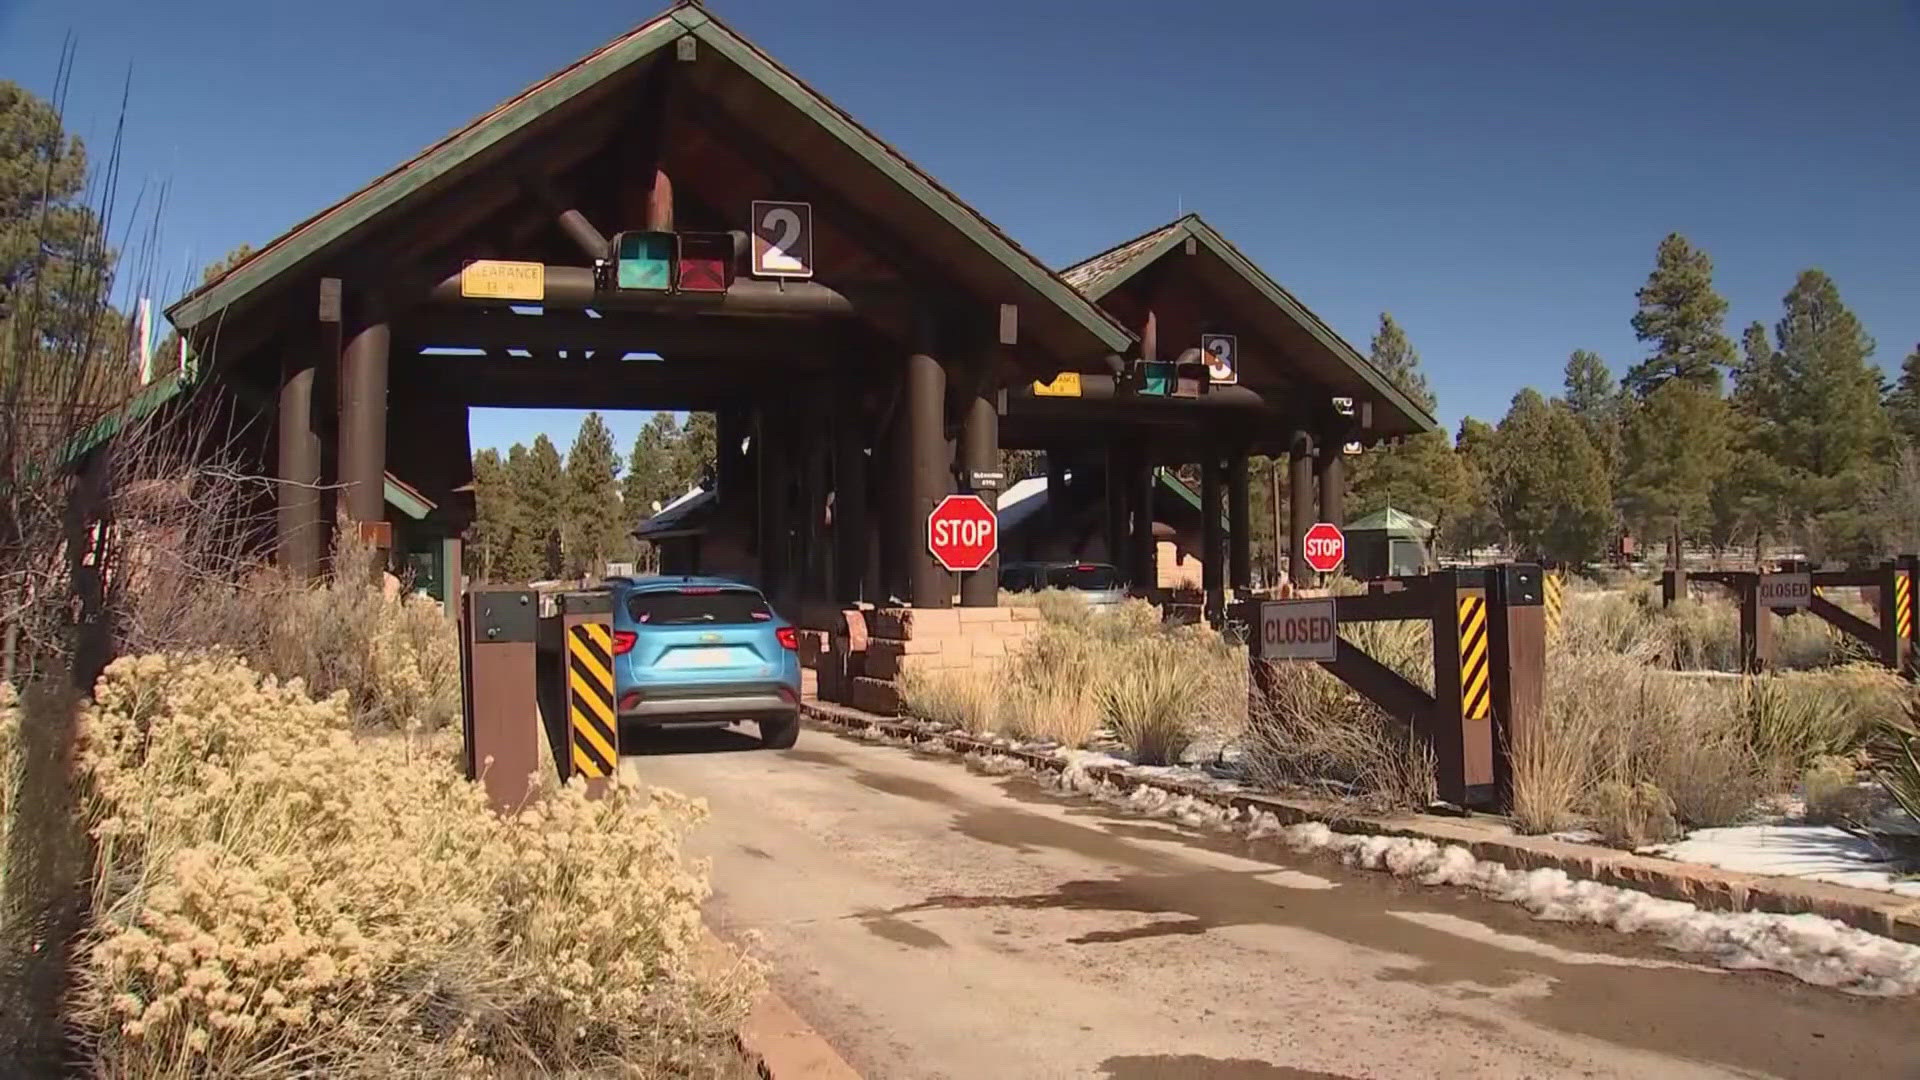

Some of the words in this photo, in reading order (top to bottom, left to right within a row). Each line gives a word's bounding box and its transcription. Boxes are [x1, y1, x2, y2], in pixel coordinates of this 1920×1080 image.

[762, 208, 802, 270] 2
[467, 265, 539, 280] LEARANCE
[1209, 339, 1231, 379] 3
[935, 519, 991, 546] STOP
[1307, 538, 1340, 556] STOP
[1761, 583, 1807, 597] CLOSED
[1265, 617, 1331, 645] CLOSED
